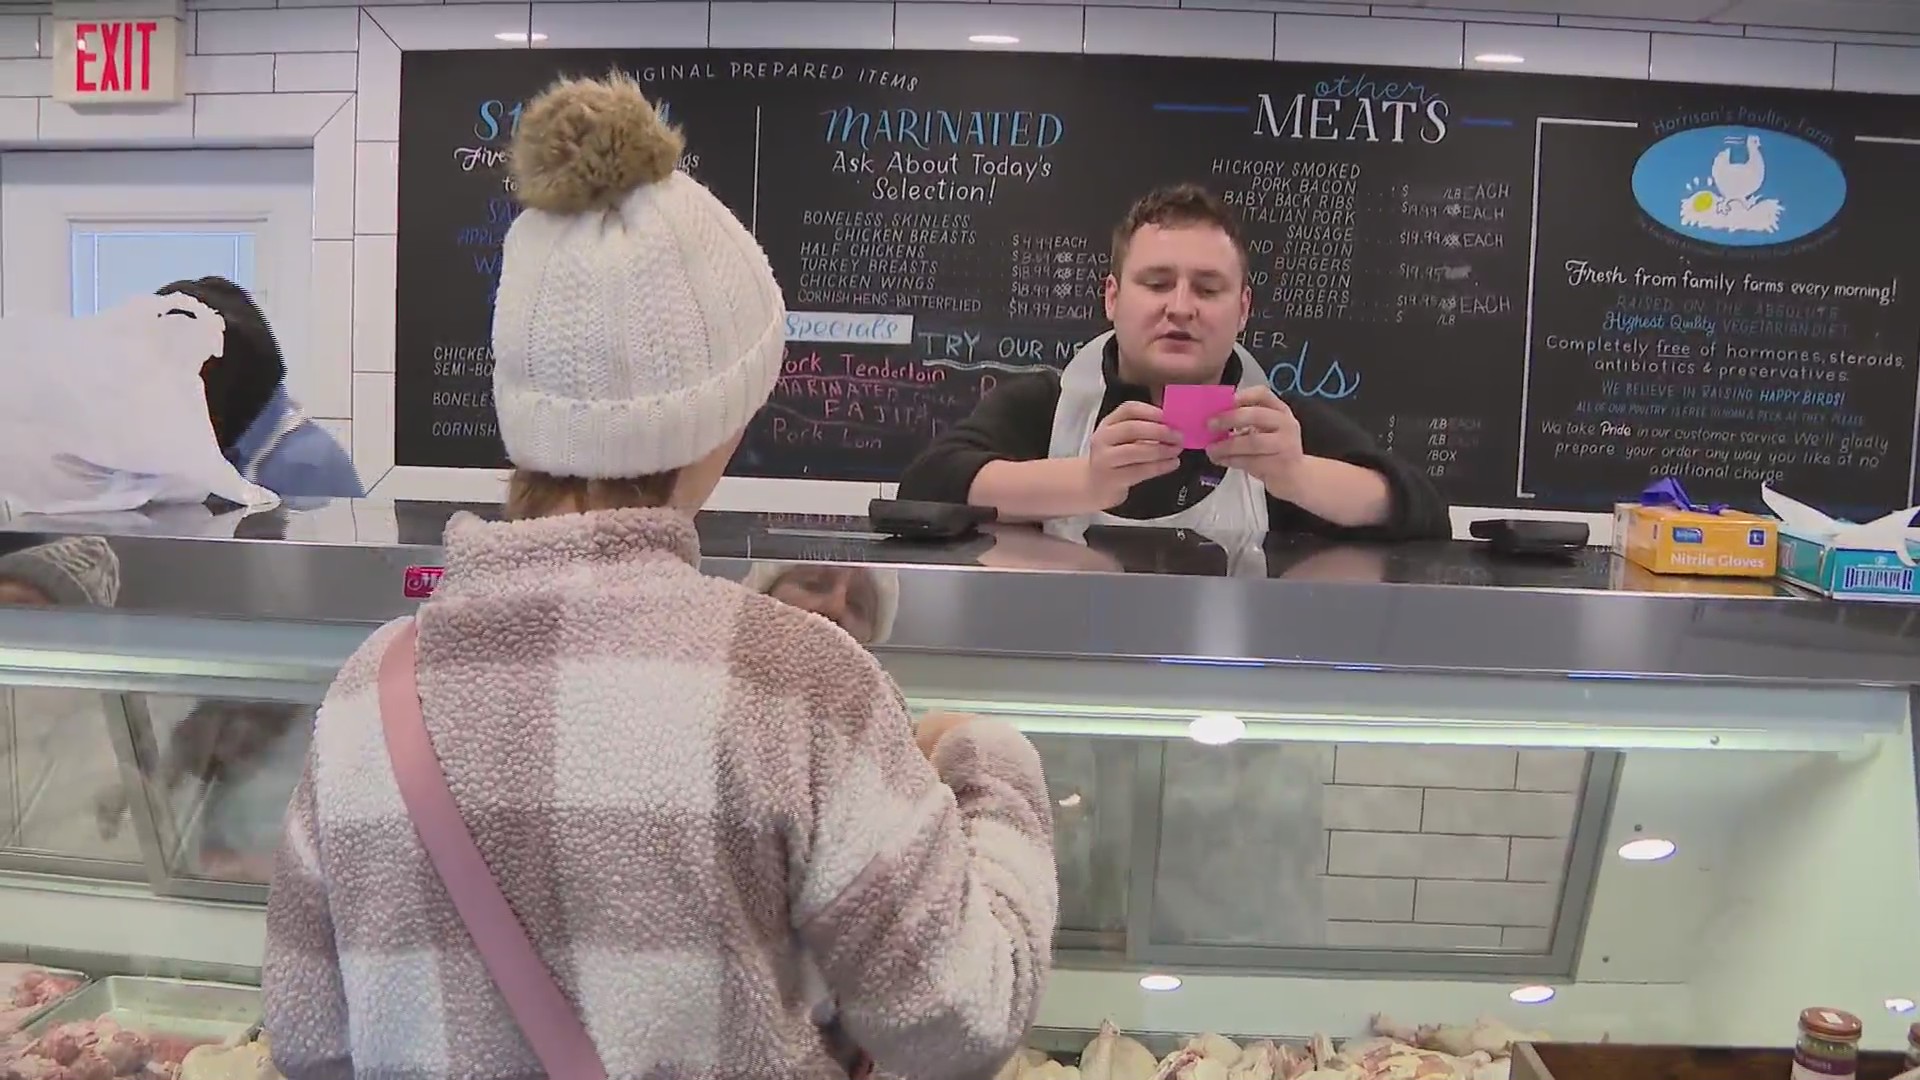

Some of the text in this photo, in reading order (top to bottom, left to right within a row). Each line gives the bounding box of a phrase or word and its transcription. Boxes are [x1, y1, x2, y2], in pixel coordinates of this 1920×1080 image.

[76, 22, 157, 92] EXIT
[730, 62, 844, 79] PREPARED
[859, 67, 919, 91] ITEMS
[1315, 74, 1440, 103] other
[820, 106, 1063, 150] MARINATED
[1253, 94, 1449, 144] MEATS
[454, 145, 508, 171] Five
[832, 150, 1052, 183] Ask About Today's
[1212, 158, 1361, 180] HICKORY SMOKED
[872, 176, 996, 206] Selection!
[1252, 176, 1357, 195] PORK BACON
[1223, 190, 1356, 211] BABY BACK RIBS
[892, 213, 970, 229] SKINLESS
[1242, 206, 1356, 226] ITALIAN PORK
[1463, 205, 1504, 219] EACH
[834, 227, 977, 244] CHICKEN BREASTS
[1287, 224, 1353, 241] SAUSAGE
[1464, 232, 1503, 247] EACH
[800, 242, 927, 259] HALF CHICKENS
[1054, 236, 1087, 249] EACH
[1283, 240, 1353, 257] SIRLOIN
[801, 257, 938, 274] TURKEY BREASTS
[1275, 256, 1351, 271] BURGERS
[800, 273, 935, 290] CHICKEN WINGS
[1281, 272, 1351, 288] SIRLOIN
[1565, 259, 1897, 306] Fresh from family farms every morning!
[798, 289, 850, 303] CORNISH
[1273, 288, 1350, 303] BURGERS
[1461, 295, 1510, 313] EACH
[1056, 304, 1093, 319] EACH
[1285, 303, 1347, 319] RABBIT
[1603, 310, 1665, 333] Highest
[1670, 314, 1716, 336] Quality
[918, 331, 981, 361] TRY
[999, 337, 1042, 359] OUR
[1546, 335, 1905, 370] Completely free of hormones, steroids,
[840, 353, 946, 382] Tenderloin
[1595, 358, 1695, 375] antibiotics
[1703, 362, 1712, 374] &
[1602, 379, 1846, 407] WE BELIEVE IN RAISING HAPPY BIRDS!
[432, 422, 497, 436] CORNISH
[1541, 420, 1888, 455] We take Pride in our customer service We'll gladly
[1555, 442, 1879, 468] prepare your order any way you like at no
[1650, 462, 1784, 485] additional charge
[1670, 552, 1715, 567] Nitrile
[1718, 553, 1764, 568] Gloves
